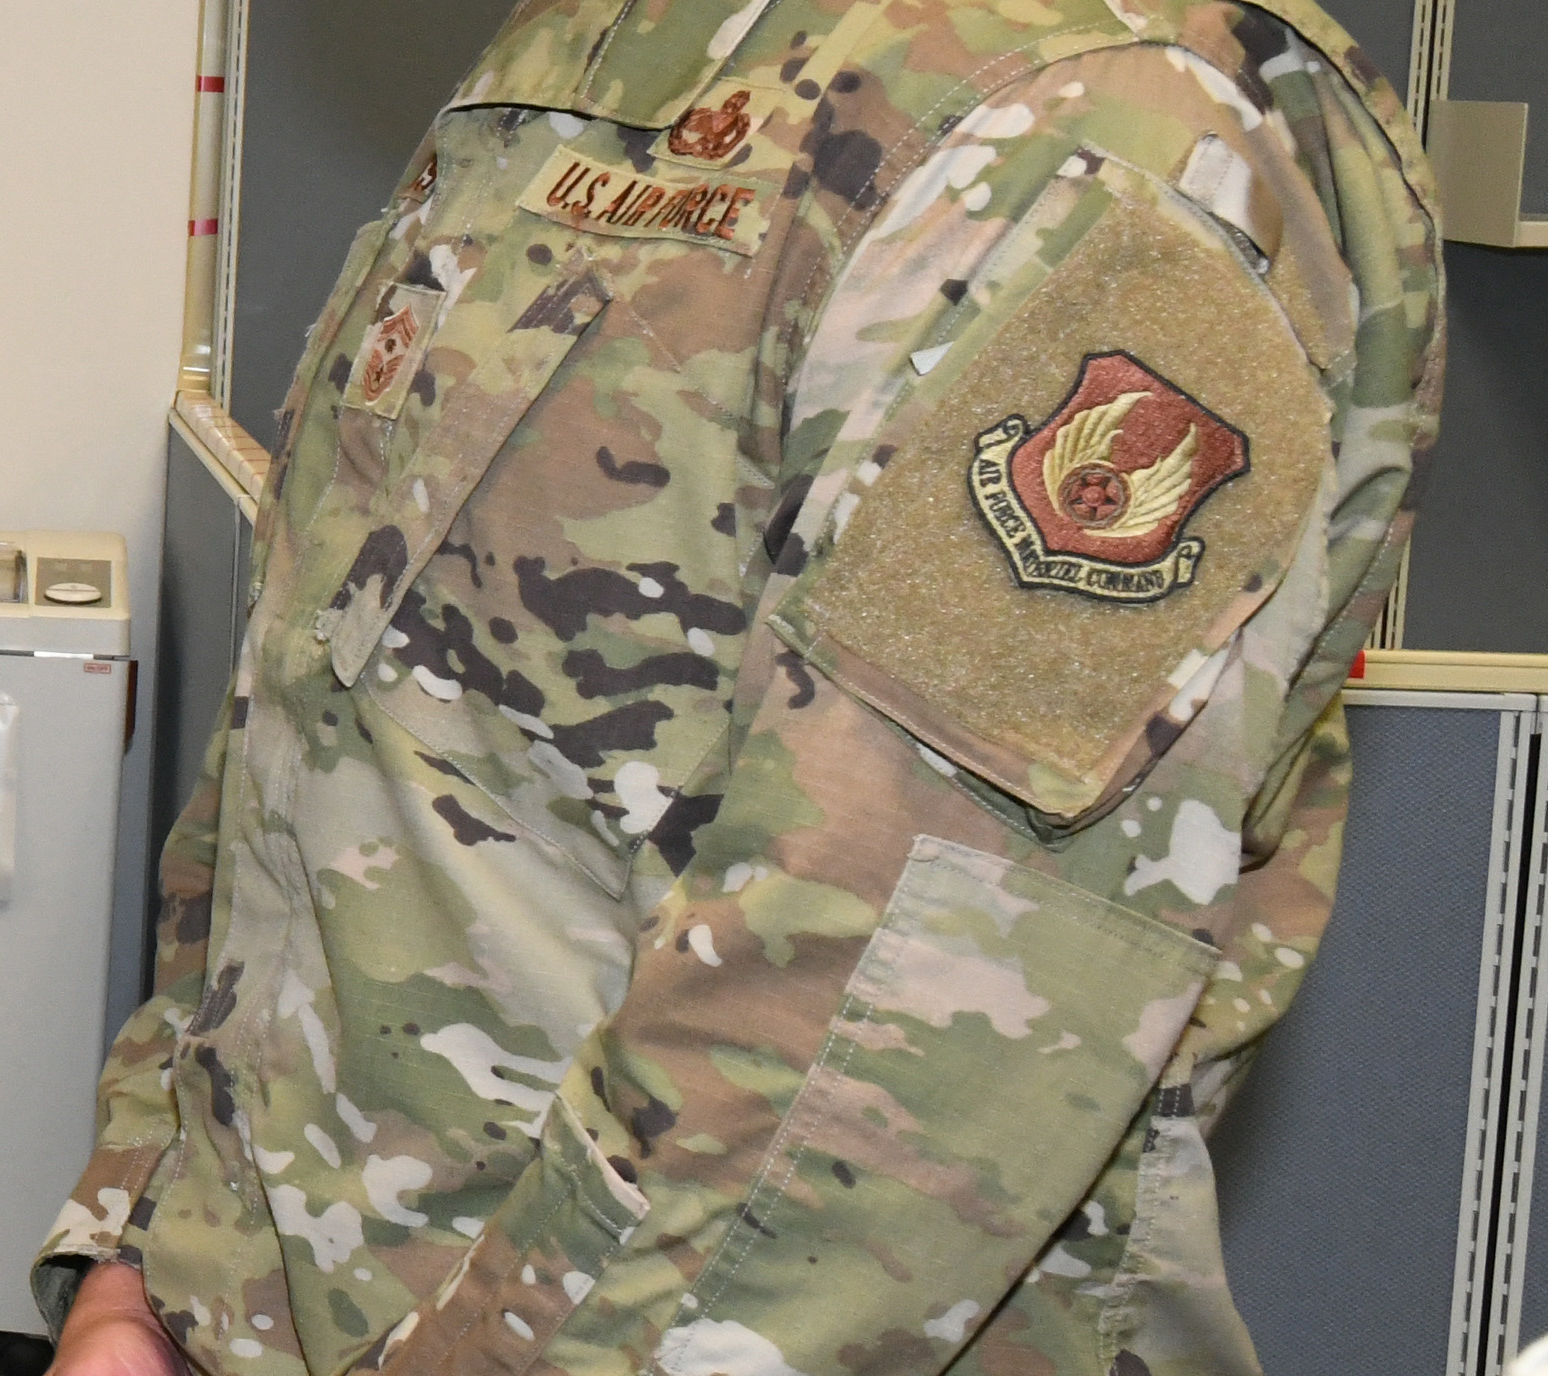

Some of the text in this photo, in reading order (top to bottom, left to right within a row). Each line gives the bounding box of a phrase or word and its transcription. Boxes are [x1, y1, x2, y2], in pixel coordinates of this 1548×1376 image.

[545, 161, 756, 241] U.S. AIR FORCE
[978, 457, 1003, 489] AIR
[983, 489, 1027, 540] FORCE
